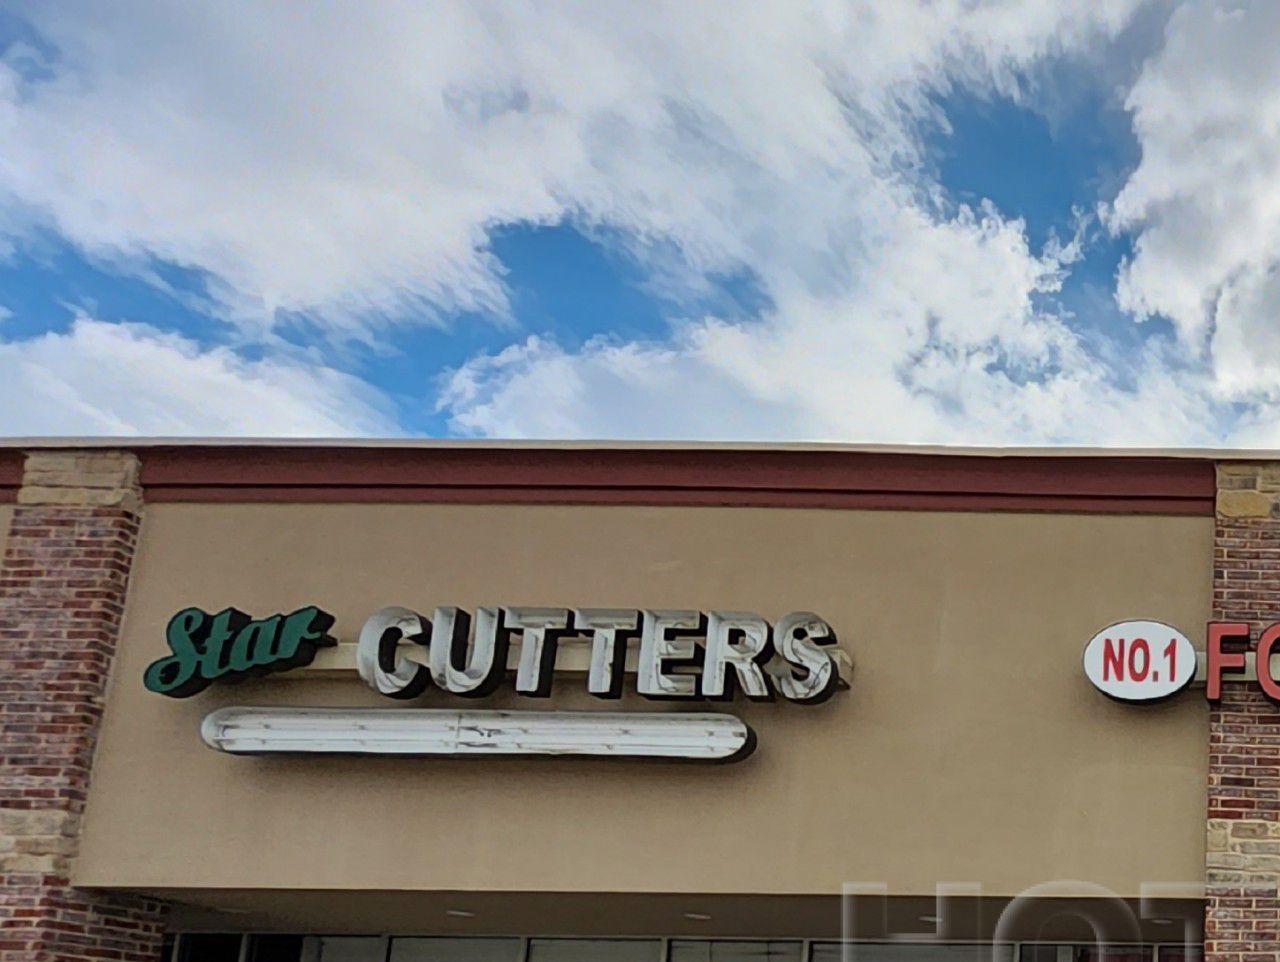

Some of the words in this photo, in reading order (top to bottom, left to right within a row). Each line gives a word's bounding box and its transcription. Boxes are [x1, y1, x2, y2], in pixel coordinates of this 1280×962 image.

[142, 606, 330, 695] Star
[356, 605, 842, 701] CUTTERS
[1102, 636, 1178, 683] NO.1
